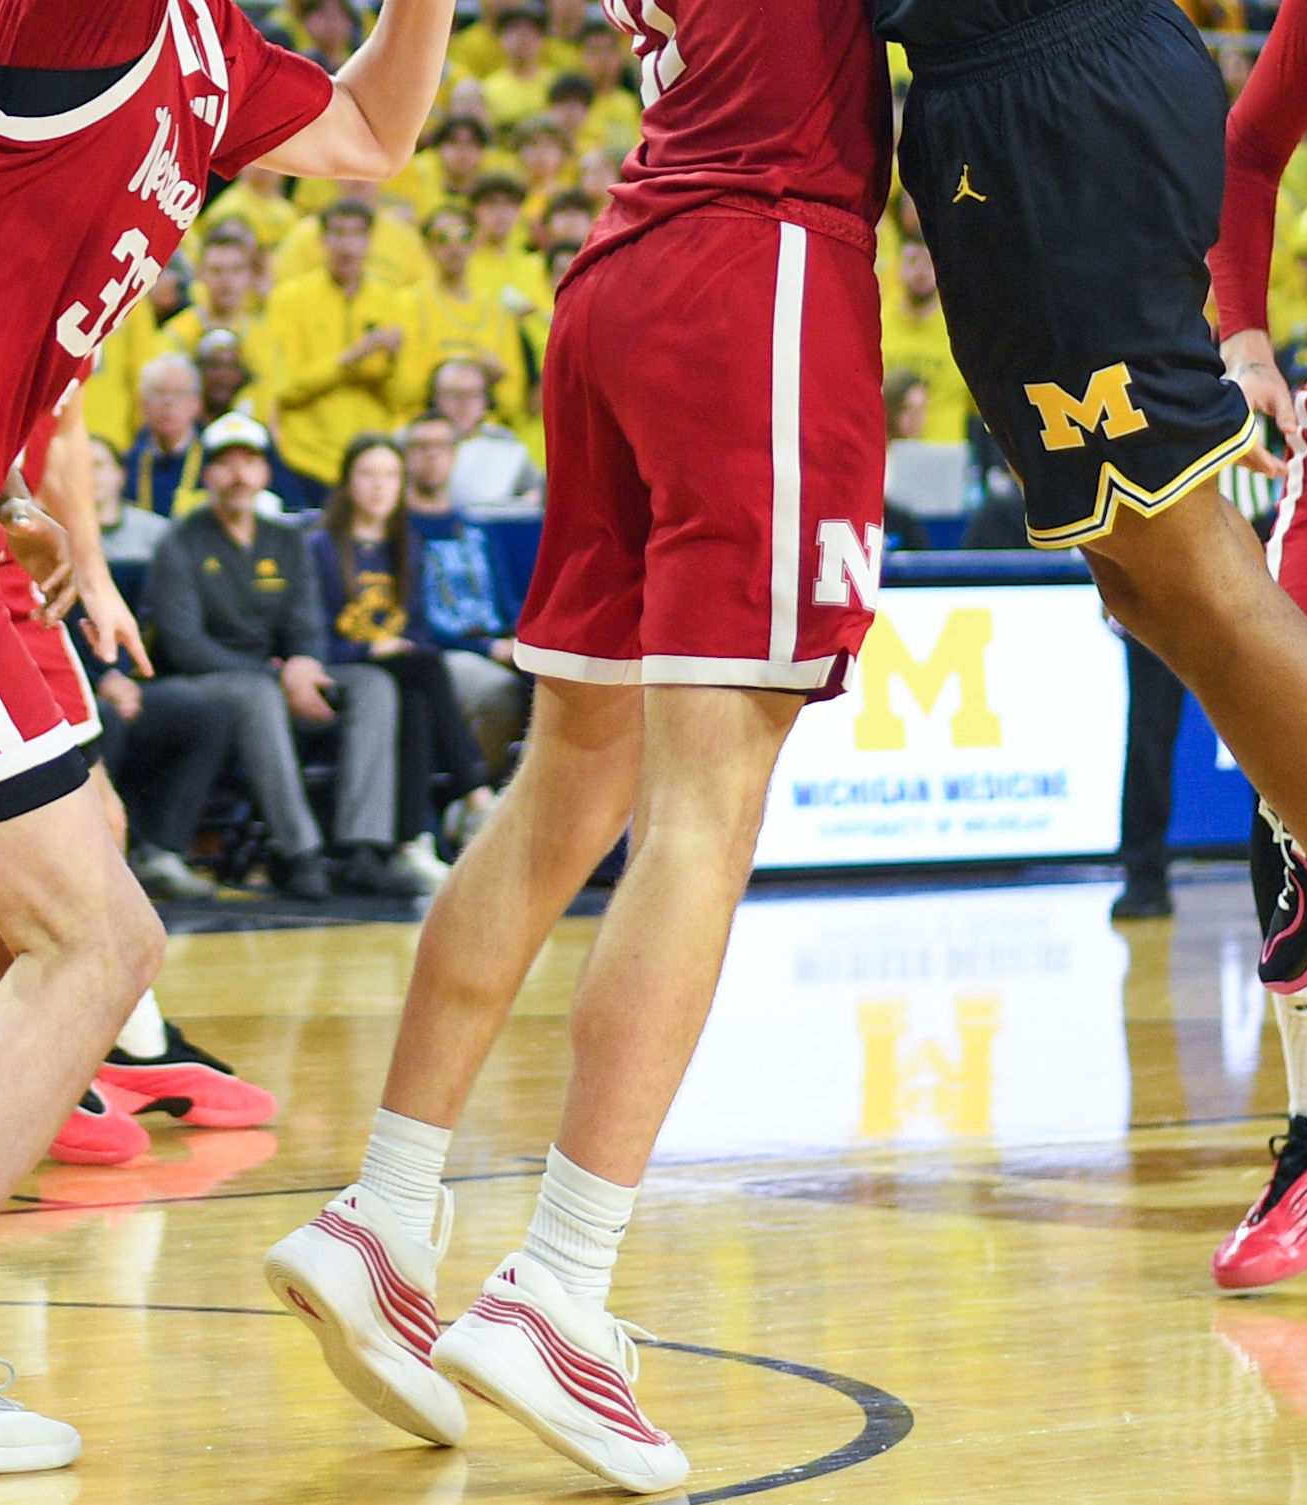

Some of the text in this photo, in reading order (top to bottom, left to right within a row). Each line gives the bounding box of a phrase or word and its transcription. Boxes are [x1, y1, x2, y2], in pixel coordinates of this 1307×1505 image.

[1024, 362, 1149, 451] M
[812, 519, 883, 611] N
[853, 606, 1003, 752] M
